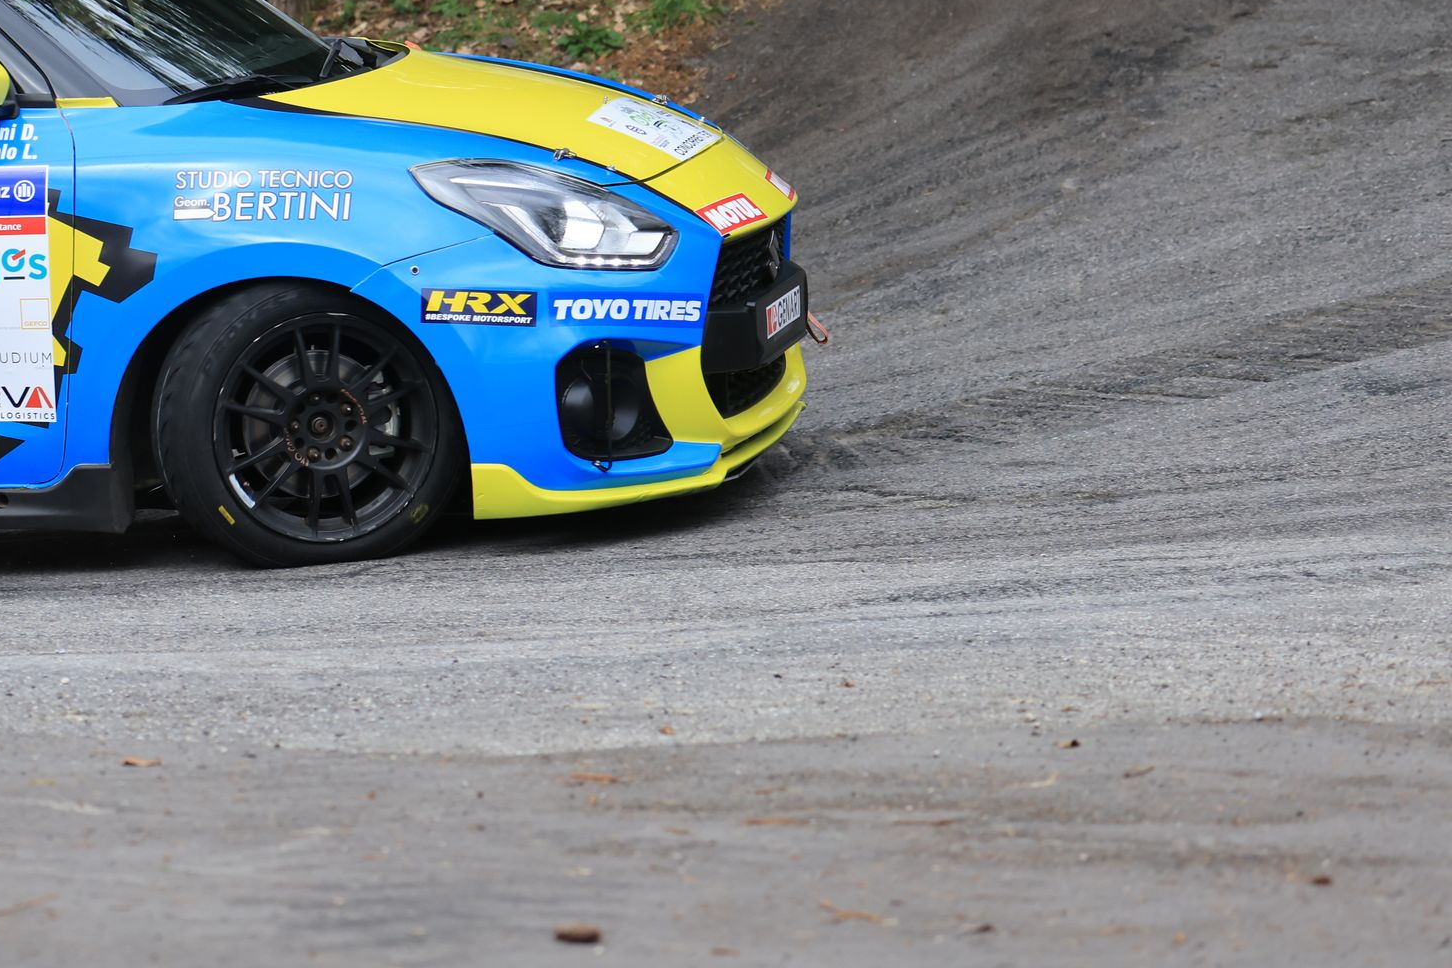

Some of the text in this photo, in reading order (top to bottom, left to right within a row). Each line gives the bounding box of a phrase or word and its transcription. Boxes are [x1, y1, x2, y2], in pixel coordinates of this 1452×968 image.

[21, 123, 39, 141] D.
[22, 144, 38, 160] L.
[175, 169, 353, 190] STUDIO TECNICO
[174, 192, 352, 221] Geom. BERTINI
[704, 197, 763, 230] MOTUL
[426, 290, 532, 315] HRX
[553, 298, 702, 322] TOYO TIRES
[425, 314, 533, 324] #BESPOKE MOTORSPORT
[0, 412, 55, 420] LOGISTICS
